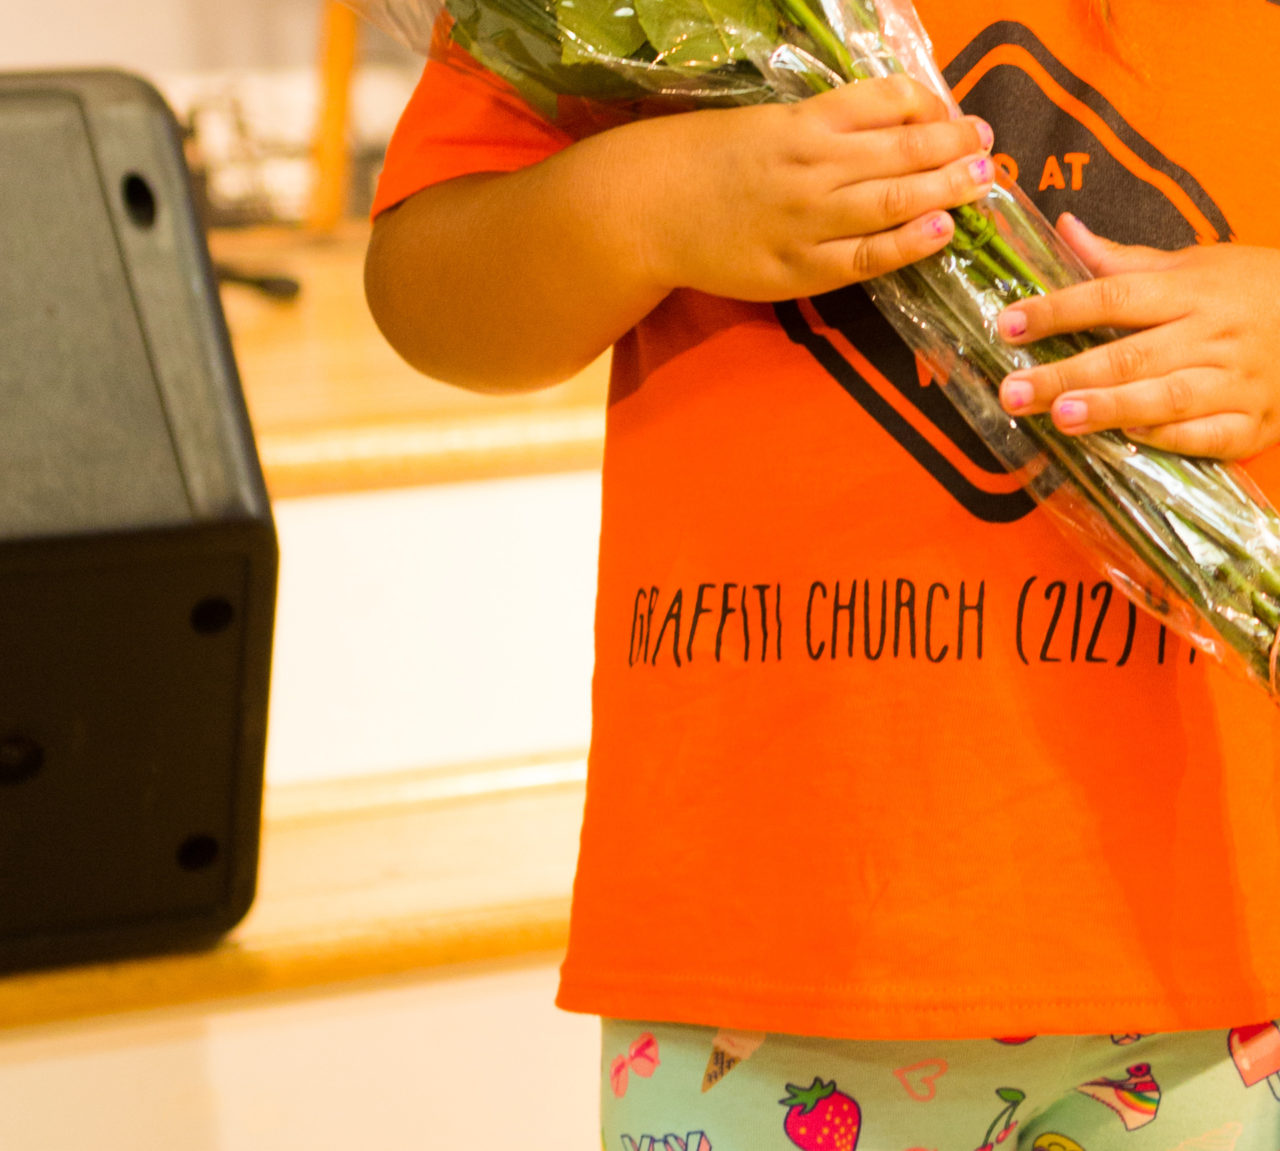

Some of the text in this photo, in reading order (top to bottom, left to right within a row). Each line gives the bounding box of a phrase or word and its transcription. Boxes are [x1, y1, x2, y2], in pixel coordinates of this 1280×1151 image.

[1038, 152, 1090, 191] AT
[629, 583, 782, 668] GRAFFITI
[806, 579, 985, 664] CHURCH
[1016, 575, 1137, 667] (212)
